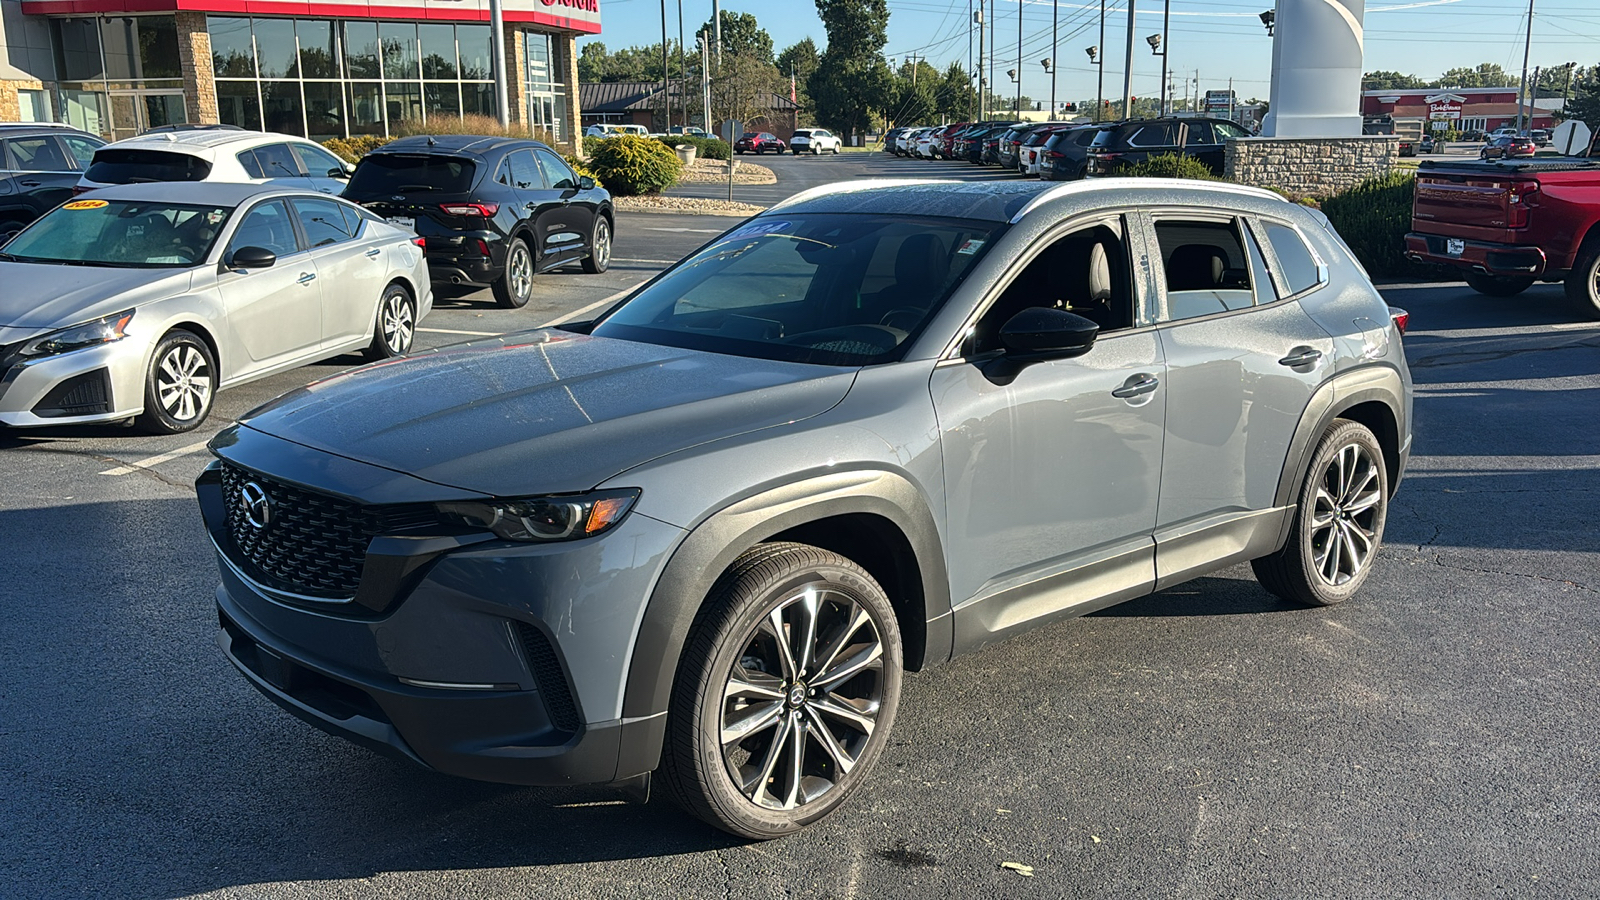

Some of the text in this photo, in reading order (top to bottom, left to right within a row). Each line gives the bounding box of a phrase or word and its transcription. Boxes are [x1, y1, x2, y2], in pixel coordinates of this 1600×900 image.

[725, 222, 788, 239] 2024
[839, 575, 897, 645] GOODYEAR
[708, 751, 740, 814] TOURING
